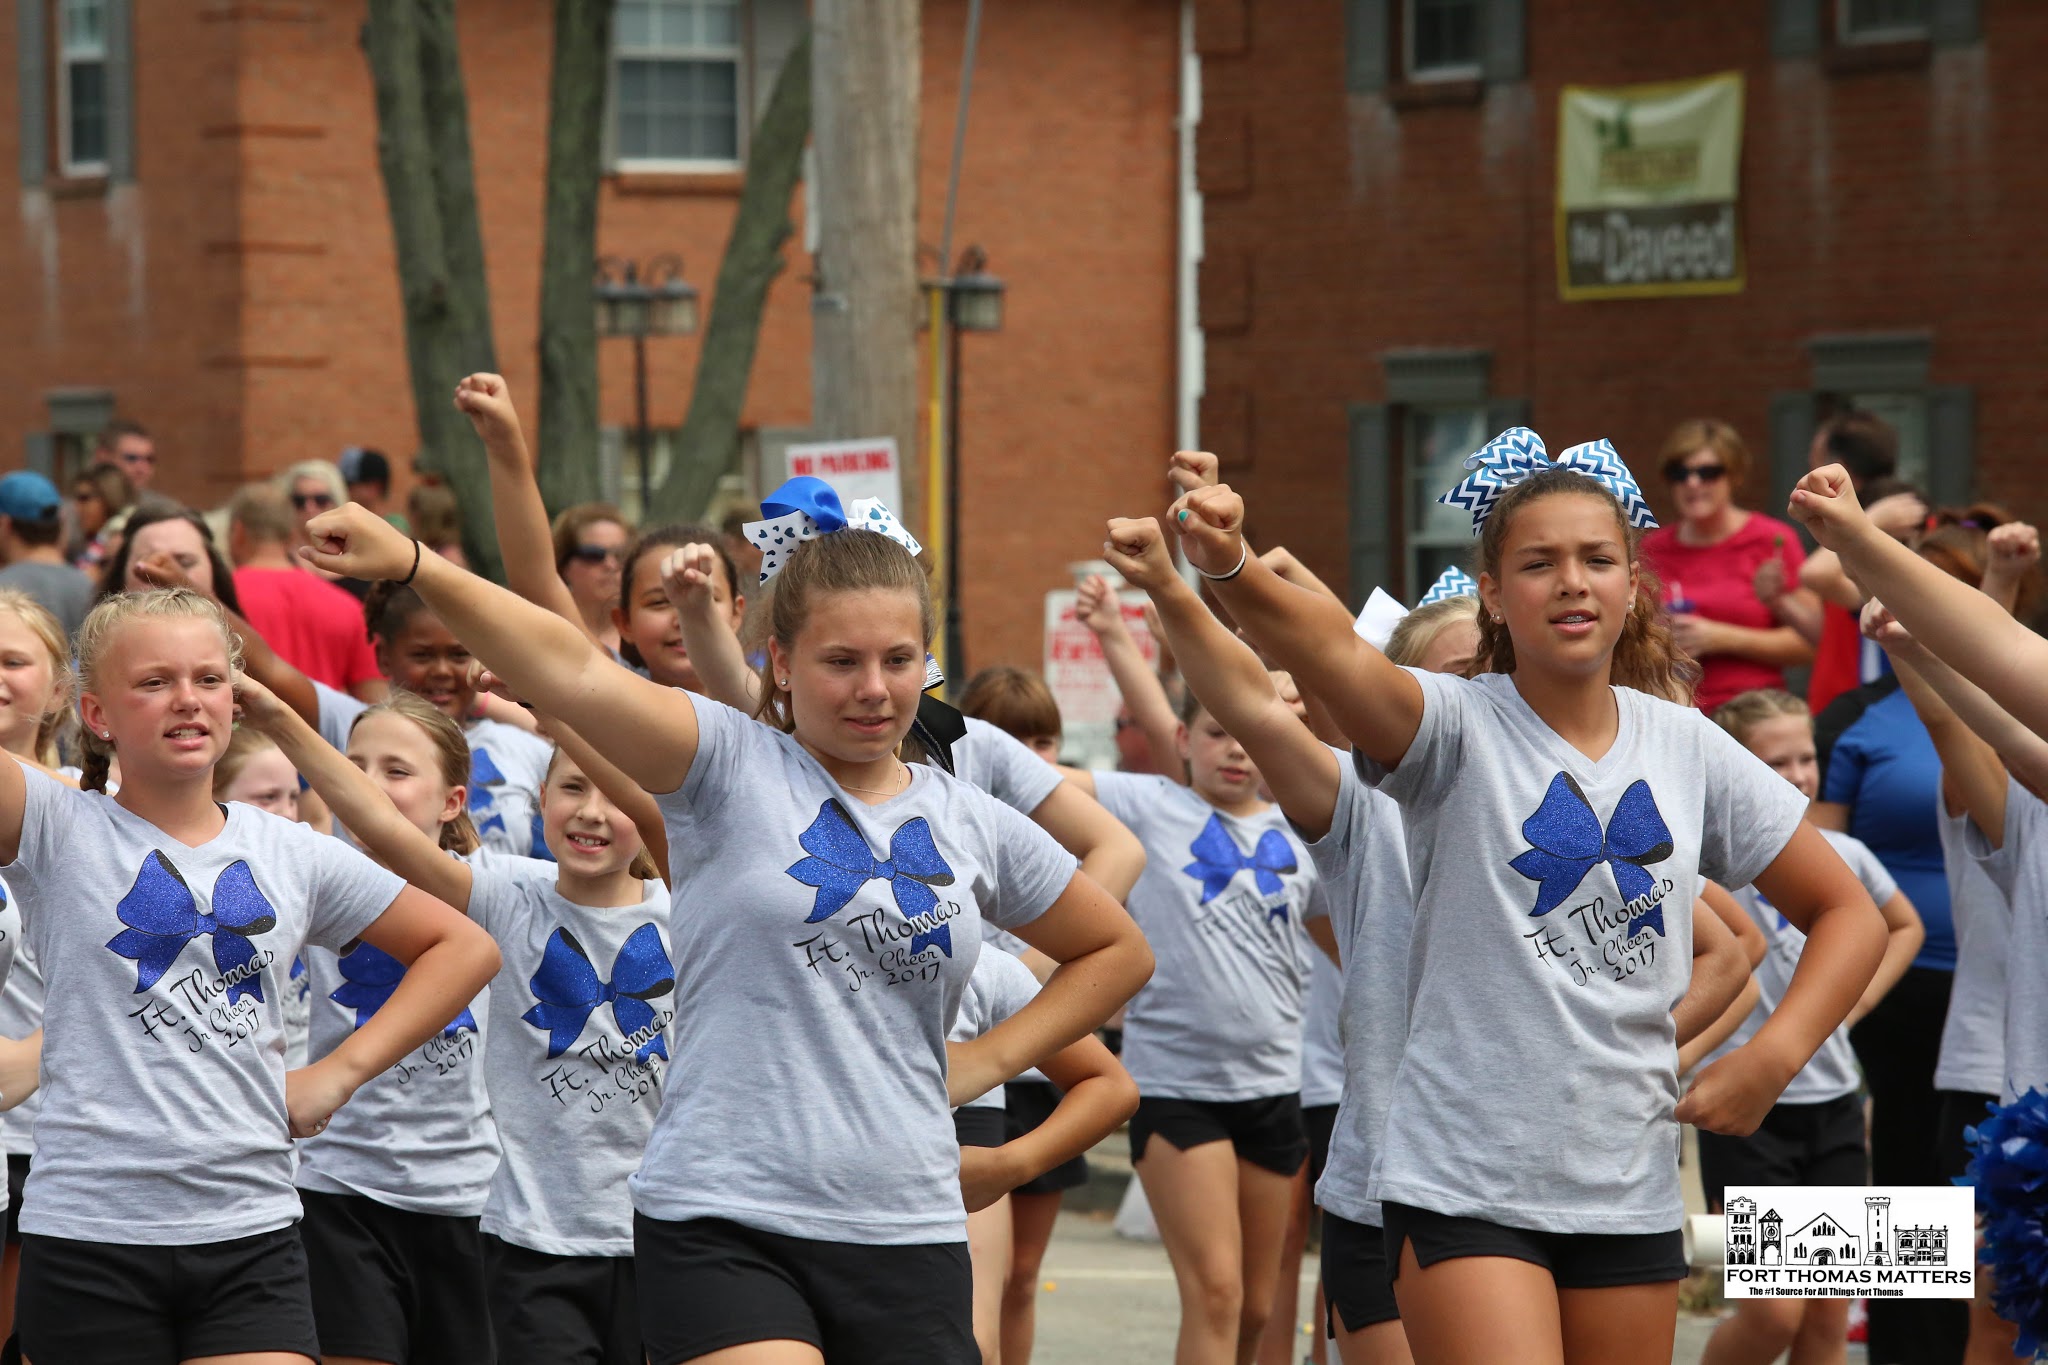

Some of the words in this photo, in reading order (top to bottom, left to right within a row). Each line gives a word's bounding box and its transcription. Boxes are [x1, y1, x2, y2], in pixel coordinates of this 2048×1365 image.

[820, 448, 890, 475] PARKING
[793, 931, 850, 978] Ft.
[846, 899, 961, 954] Thomas
[1523, 925, 1575, 969] Ft.
[1568, 878, 1674, 946] Thomas
[846, 963, 875, 992] Jr.
[879, 948, 938, 972] Cheer
[886, 961, 940, 986] 2017
[1571, 958, 1600, 987] Jr.
[1603, 931, 1652, 966] Cheer
[1612, 941, 1655, 982] 2017
[128, 998, 187, 1043] Ft.
[169, 949, 274, 1016] Thomas
[209, 998, 252, 1033] Cheer
[223, 1008, 260, 1048] 2017
[394, 1061, 423, 1085] Jr.
[422, 1031, 466, 1064] Cheer
[435, 1038, 473, 1077] 2017
[541, 1064, 589, 1106] Ft.
[578, 1009, 673, 1074] Thomas
[587, 1087, 616, 1113] Jr.
[614, 1058, 657, 1090] Cheer
[628, 1067, 663, 1104] 2017
